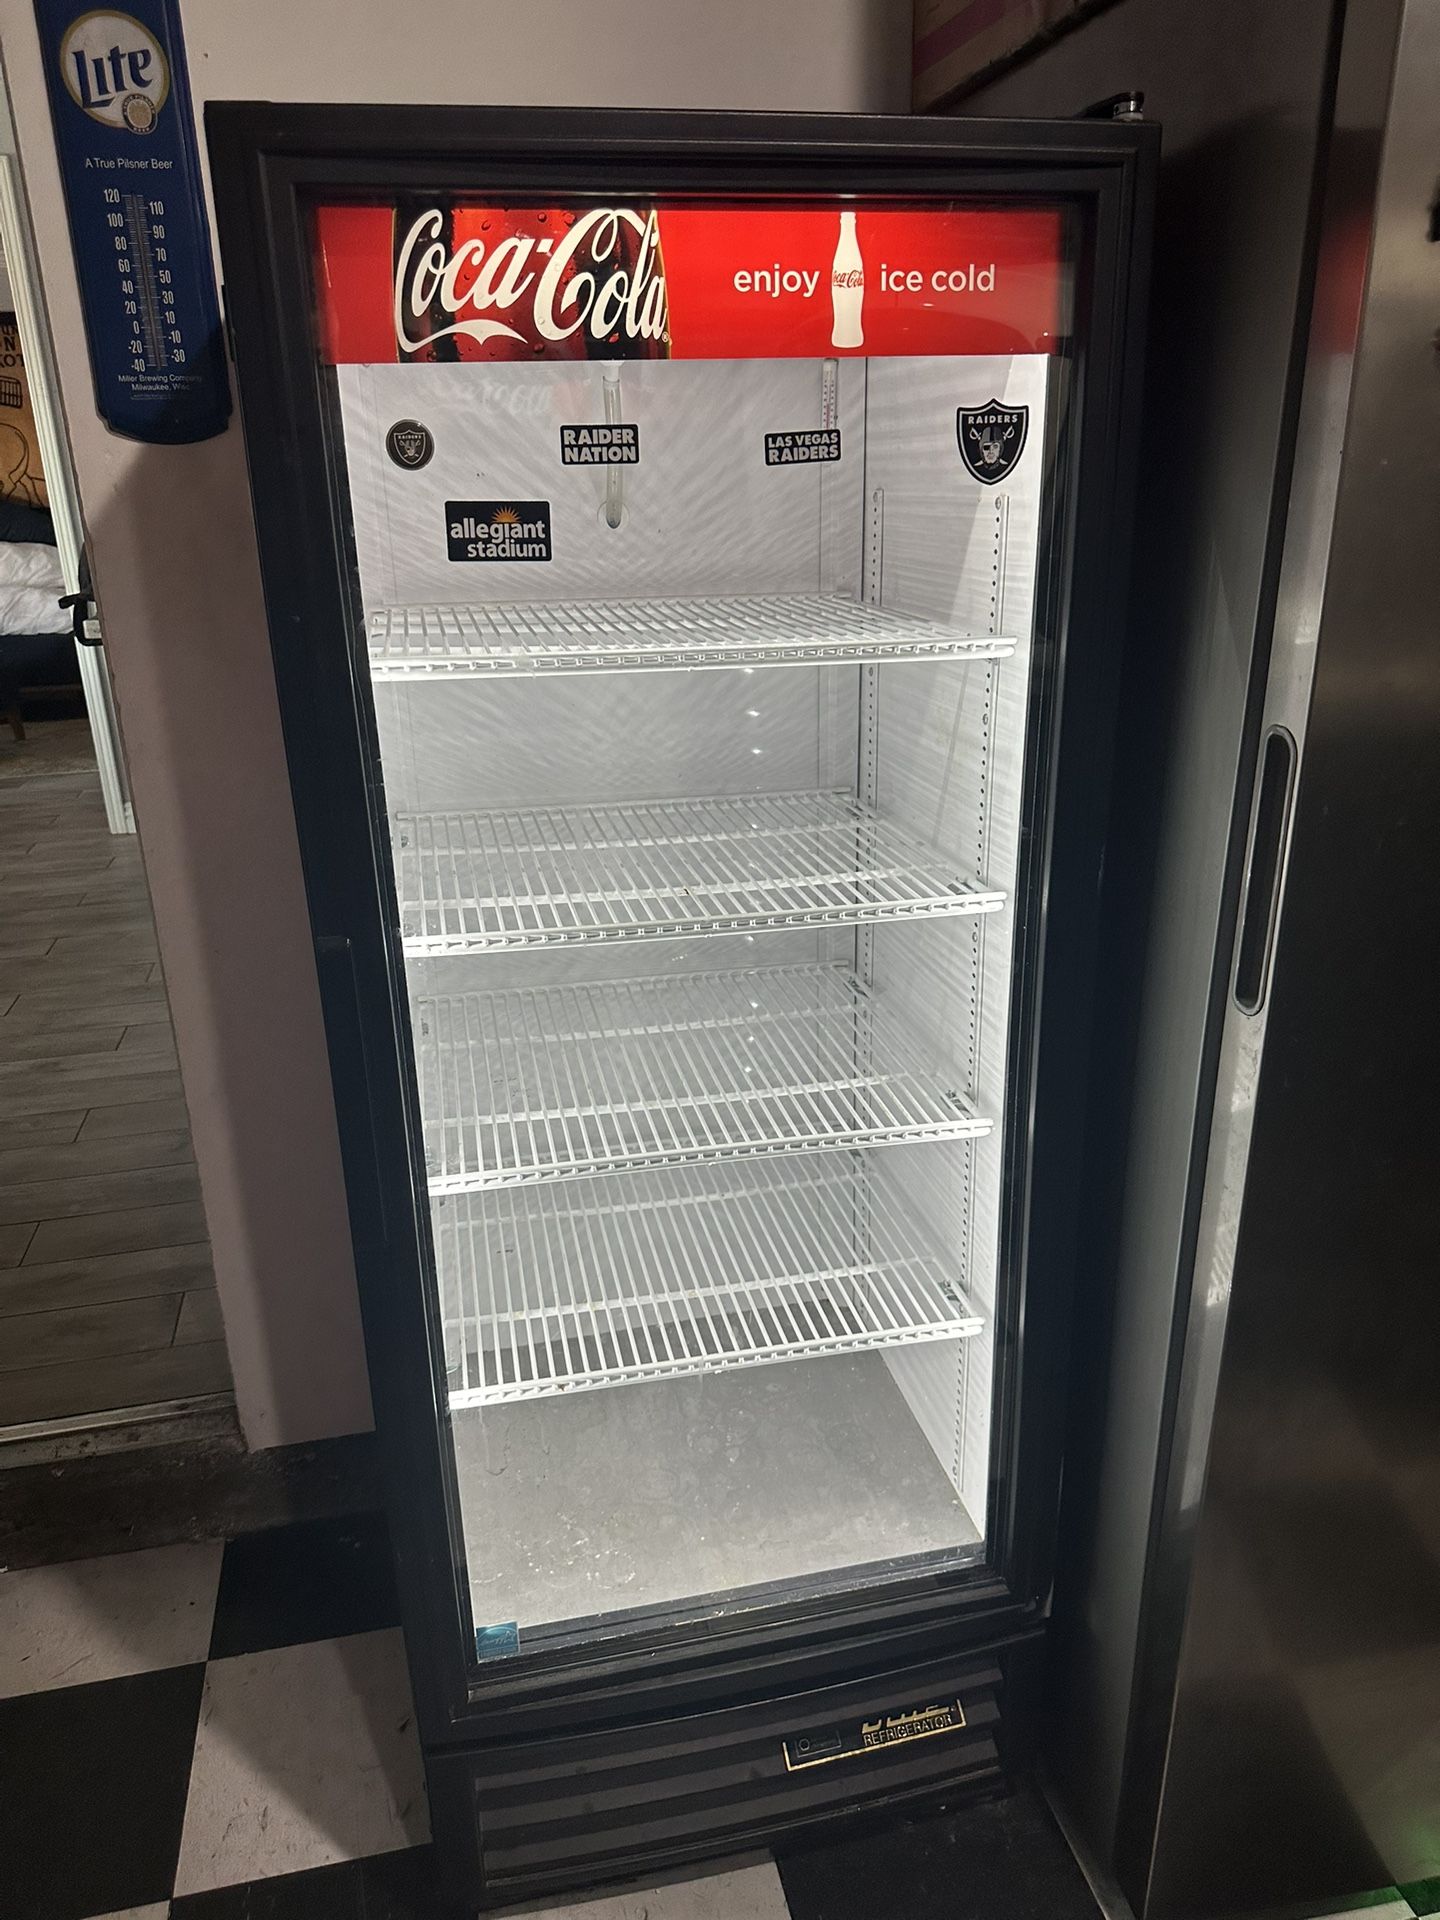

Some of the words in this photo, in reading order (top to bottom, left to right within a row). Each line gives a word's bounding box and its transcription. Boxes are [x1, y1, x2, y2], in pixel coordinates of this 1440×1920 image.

[72, 45, 153, 109] Lite
[85, 157, 93, 168] A
[93, 157, 115, 169] True
[117, 158, 149, 169] Pilsner
[151, 158, 174, 169] Beer
[104, 188, 120, 203] 120
[149, 201, 164, 216] 110
[107, 213, 124, 227] 100
[152, 225, 165, 239] 90
[114, 236, 127, 251] 80
[155, 248, 167, 262] 70
[118, 259, 131, 273] 60
[159, 270, 171, 284] 50
[394, 208, 670, 353] Coca-Cola
[733, 263, 820, 298] enjoy
[880, 263, 923, 292] ice
[931, 263, 995, 292] cold
[122, 280, 134, 294] 40
[162, 290, 174, 304] 30
[125, 301, 137, 314] 20
[165, 311, 176, 324] 10
[133, 321, 140, 334] 0
[168, 330, 181, 343] -10
[128, 340, 143, 354] -20
[171, 349, 186, 363] -30
[131, 358, 146, 372] -40
[968, 414, 1018, 425] RAIDERS
[563, 428, 635, 445] RAIDER
[768, 436, 793, 448] LAS
[795, 432, 839, 447] VEGAS
[564, 446, 637, 463] NATION
[768, 444, 840, 463] RAIDERS
[450, 517, 546, 545] allegiant
[467, 539, 547, 559] stadium
[863, 1713, 953, 1747] REFRIGERATOR
